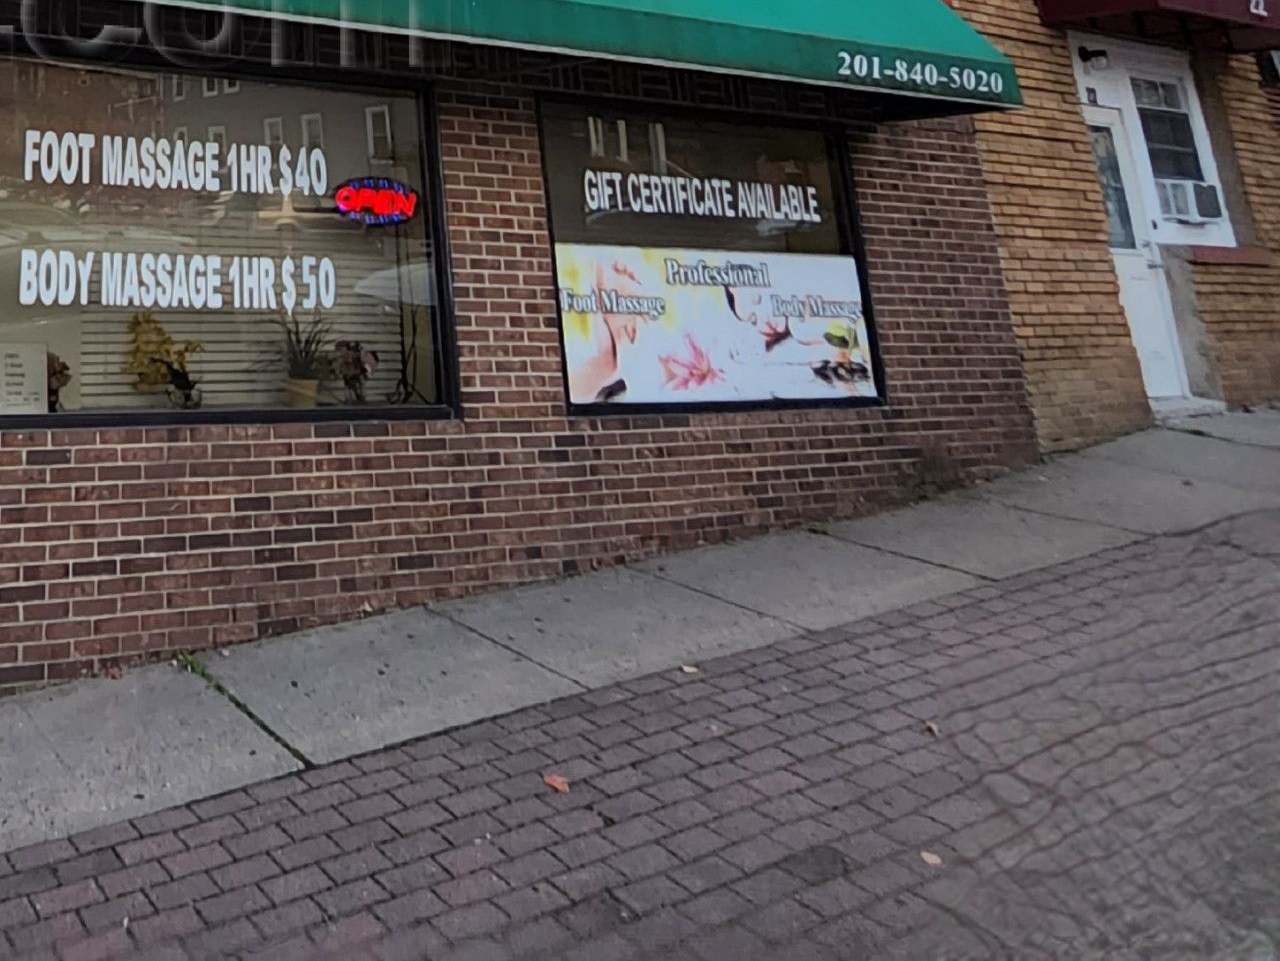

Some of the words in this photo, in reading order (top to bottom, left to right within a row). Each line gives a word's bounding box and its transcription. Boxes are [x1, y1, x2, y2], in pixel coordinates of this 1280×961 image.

[837, 51, 1005, 94] 201-840-5020
[24, 130, 95, 185] FOOT
[102, 135, 220, 192] MASSAGE
[227, 144, 274, 196] 1HR
[335, 186, 417, 218] OPEN
[584, 169, 623, 211] GIFT
[627, 173, 736, 217] CERTIFICATE
[738, 182, 822, 223] AVAILABLE
[19, 249, 96, 306] BODY
[101, 252, 222, 310] MASSAGE
[229, 256, 277, 310] 1HR
[665, 258, 771, 288] Professional
[560, 288, 597, 314] Foot
[600, 290, 666, 321] Massage
[771, 294, 806, 322] Body
